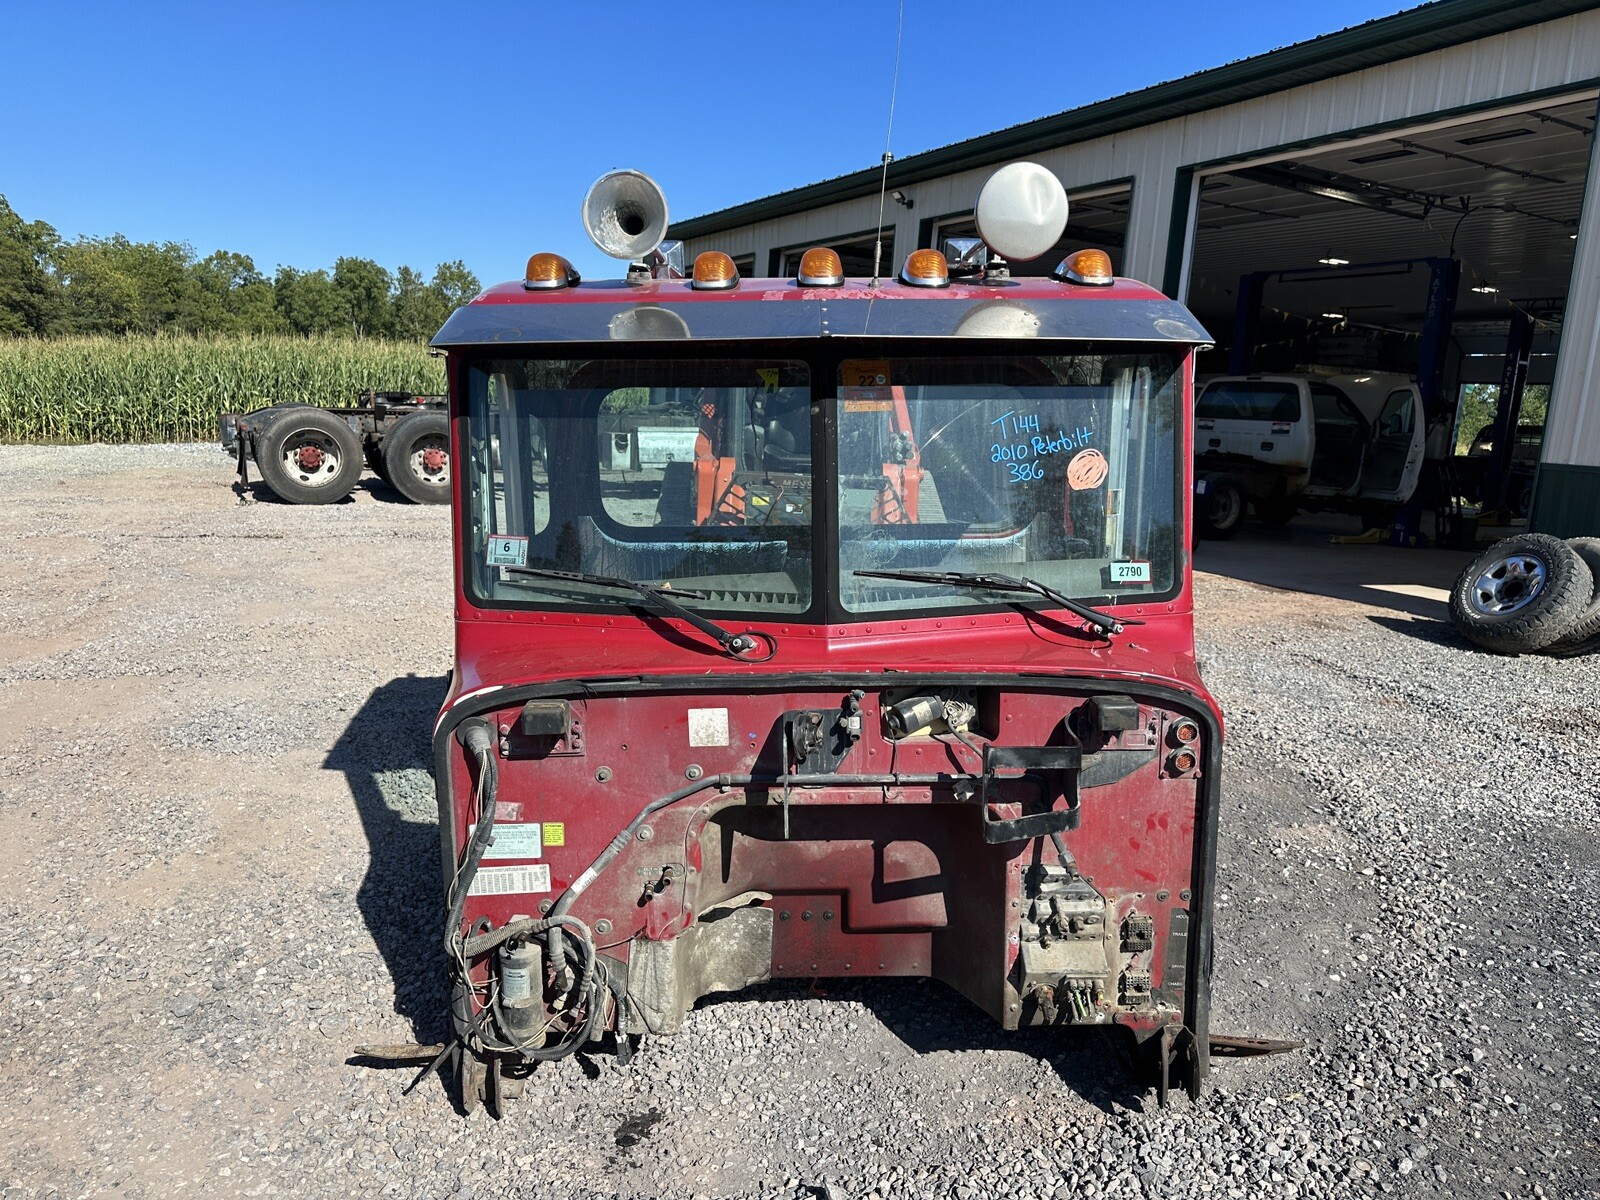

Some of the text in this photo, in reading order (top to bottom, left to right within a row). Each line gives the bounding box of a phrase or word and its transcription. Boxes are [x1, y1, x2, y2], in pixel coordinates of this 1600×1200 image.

[1427, 277, 1440, 318] ATLAS
[858, 375, 876, 387] 22
[1502, 365, 1513, 395] ATLAS
[991, 410, 1040, 440] T144
[990, 426, 1093, 463] 2010 Peterbilt
[1008, 460, 1044, 484] 386
[504, 542, 510, 552] 6
[1118, 566, 1142, 577] 2790
